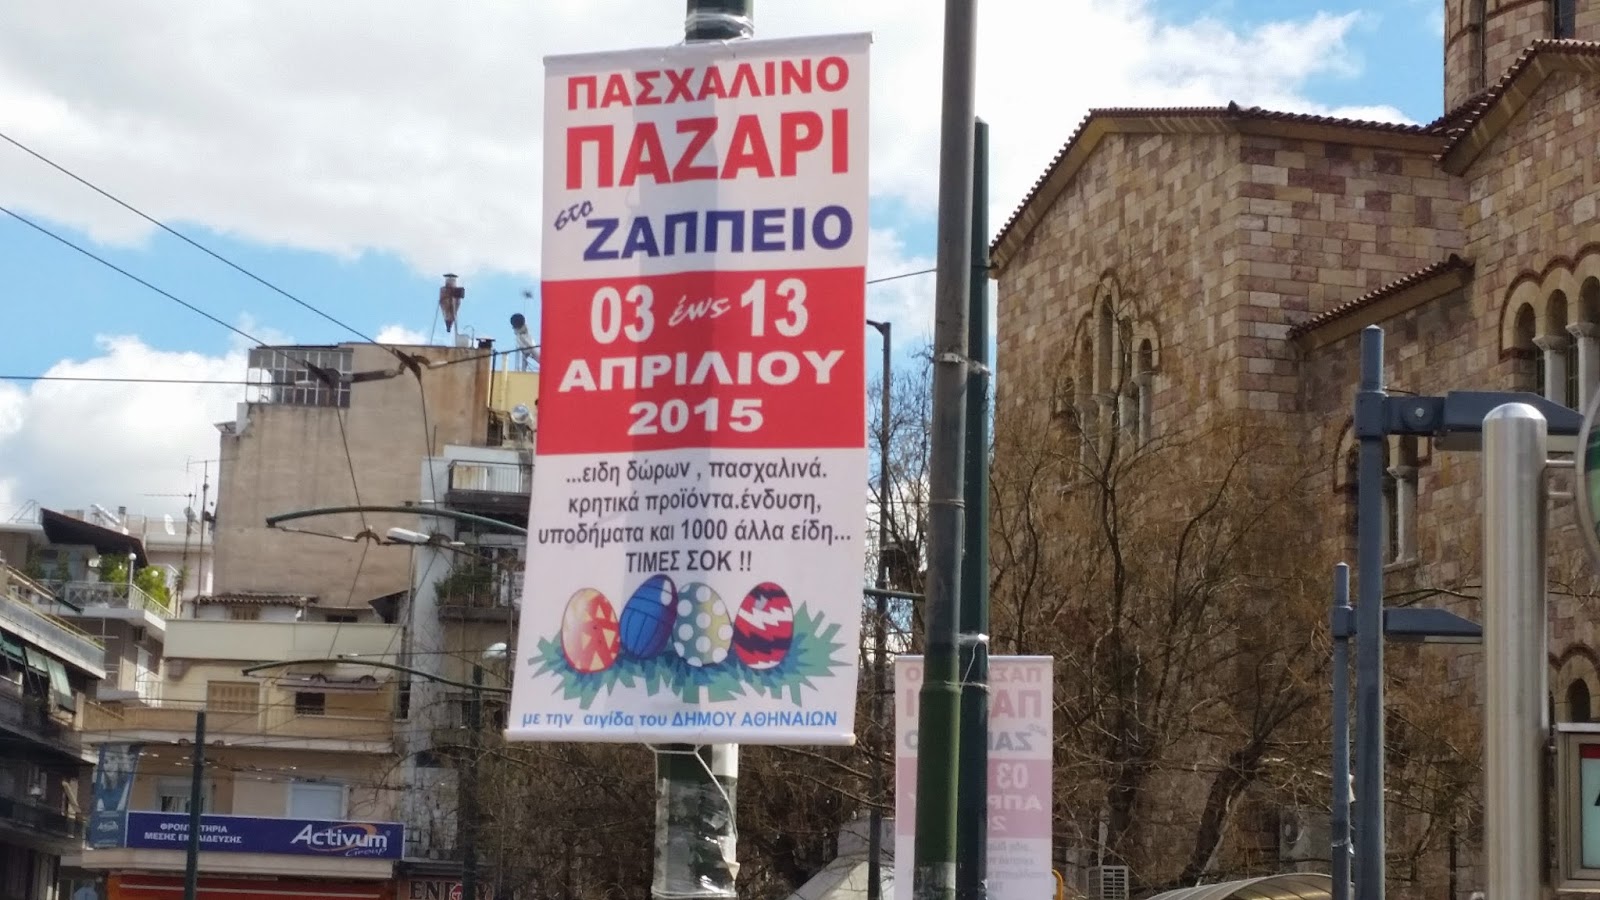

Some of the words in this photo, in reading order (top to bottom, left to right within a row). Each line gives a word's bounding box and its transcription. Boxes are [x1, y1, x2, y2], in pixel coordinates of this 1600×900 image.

[567, 56, 849, 111] ΠΑΣΧΑΛΙΝΟ
[566, 108, 849, 190] ΠΑΖΑΡΙ
[583, 205, 853, 261] ΖΑΠΠΕΙΟ
[590, 285, 655, 344] 03
[668, 294, 731, 327] έως
[740, 278, 809, 337] 13
[558, 350, 845, 392] ΑΠΡΙΛΙΟΥ
[627, 397, 764, 436] 2015
[708, 456, 828, 483] πασχαλινά.
[568, 491, 640, 518] κρητικά
[538, 522, 644, 548] υποδήματα
[650, 525, 674, 541] και
[681, 518, 728, 540] 1000
[735, 519, 784, 540] άλλα
[791, 519, 851, 546] είδη...
[626, 550, 680, 573] ΤΙΜΕΣ
[687, 550, 732, 571] ΣΟΚ
[522, 713, 541, 727] με
[545, 713, 573, 728] την
[584, 711, 634, 728] αιγίδα
[639, 714, 667, 726] του
[671, 711, 736, 726] ΔΗΜΟΥ
[741, 711, 837, 726] ΑΘΗΝΑΙΩΝ
[290, 824, 388, 848] Activum
